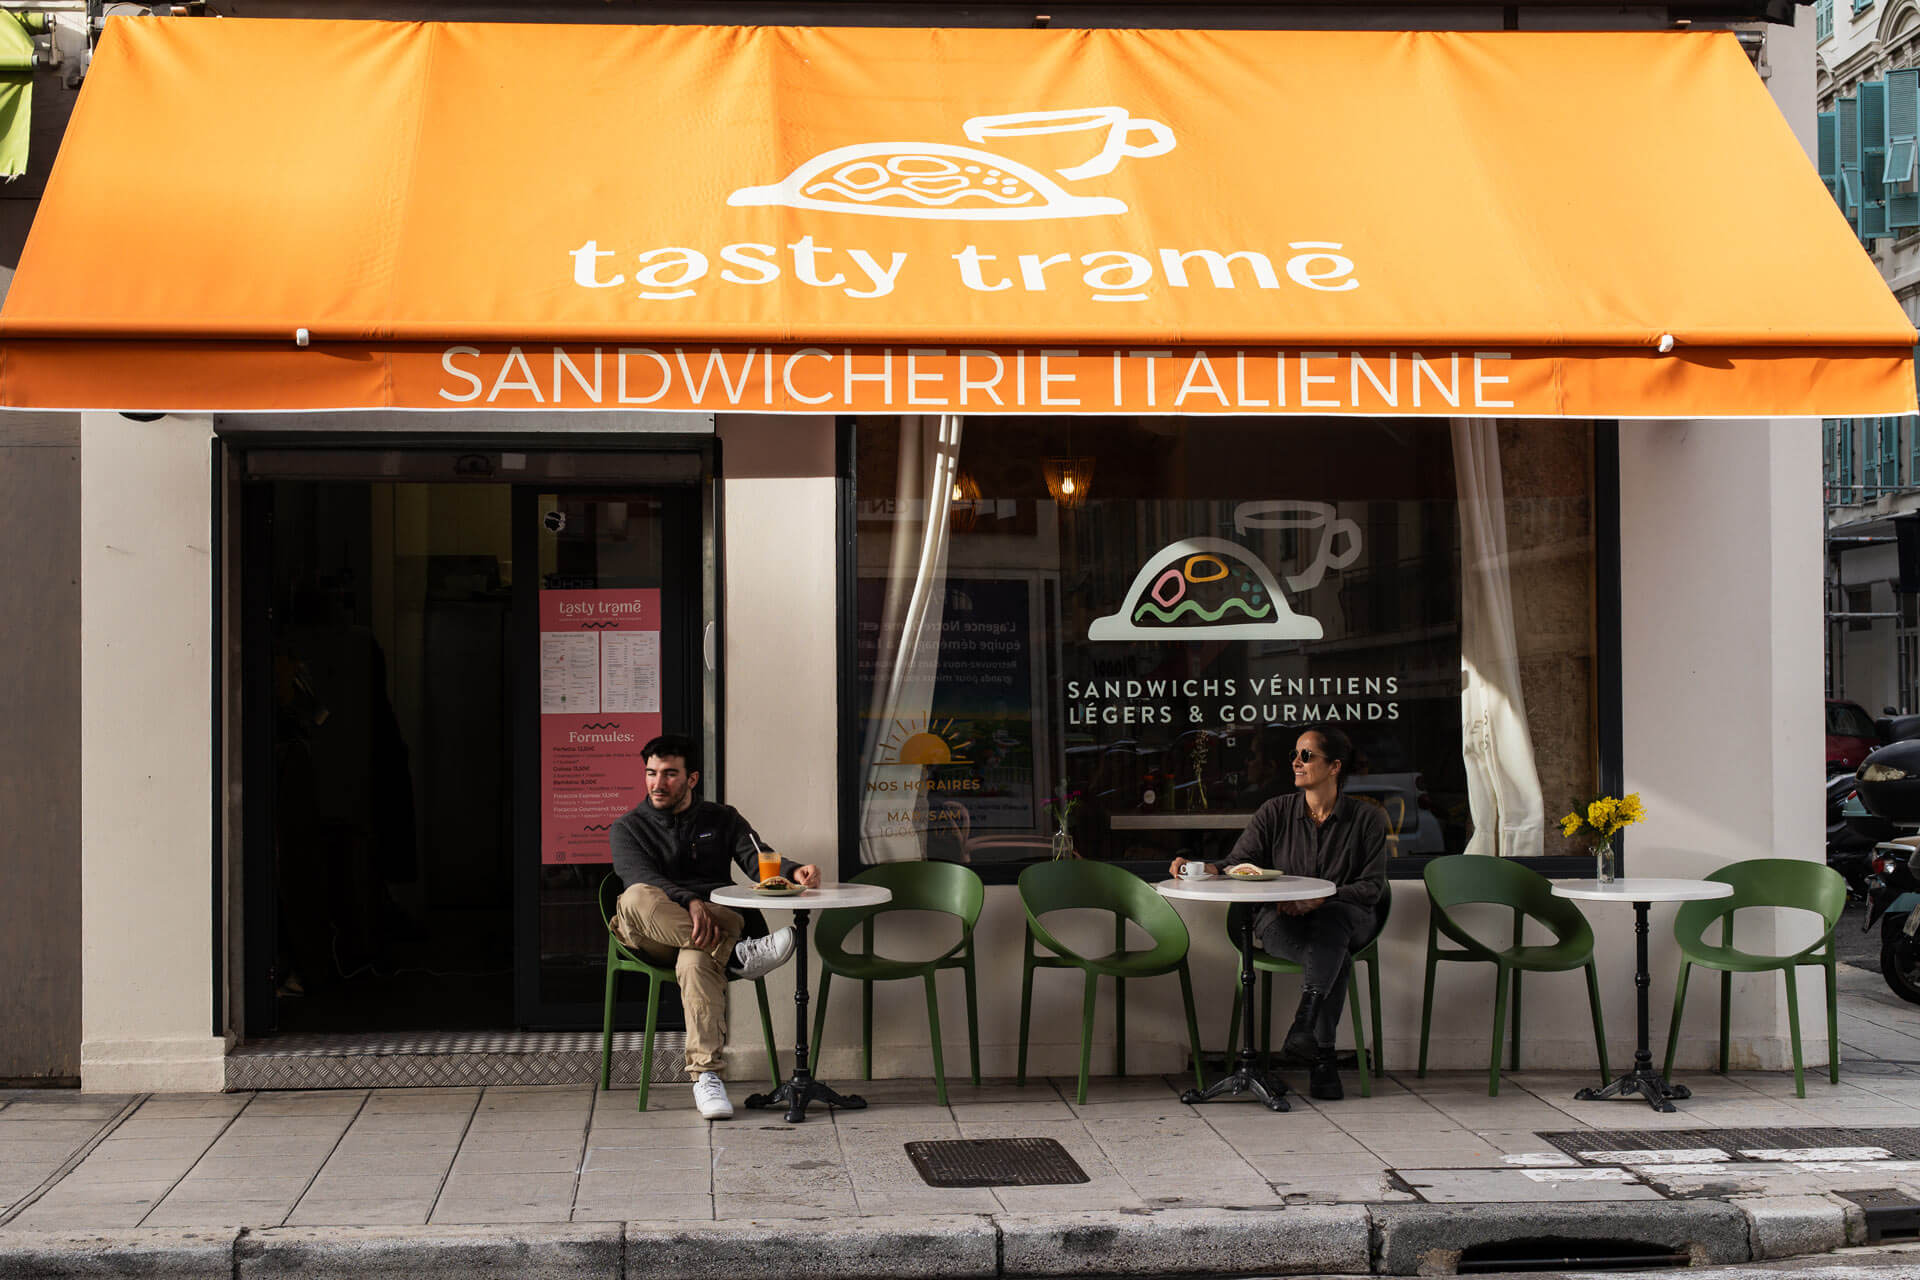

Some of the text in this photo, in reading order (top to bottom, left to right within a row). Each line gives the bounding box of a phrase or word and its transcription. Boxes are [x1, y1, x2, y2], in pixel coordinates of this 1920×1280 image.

[569, 234, 908, 301] tasty
[437, 346, 1516, 408] SANDWICHERIE ITALIENNE
[559, 600, 594, 617] tasty
[1068, 673, 1399, 699] SANDWICHS VÉNITIENS
[1069, 702, 1400, 725] LÉGERS & GOURMANDS
[568, 730, 635, 744] Formules:
[866, 779, 981, 793] NOS HORAIRES
[929, 810, 961, 821] SAM
